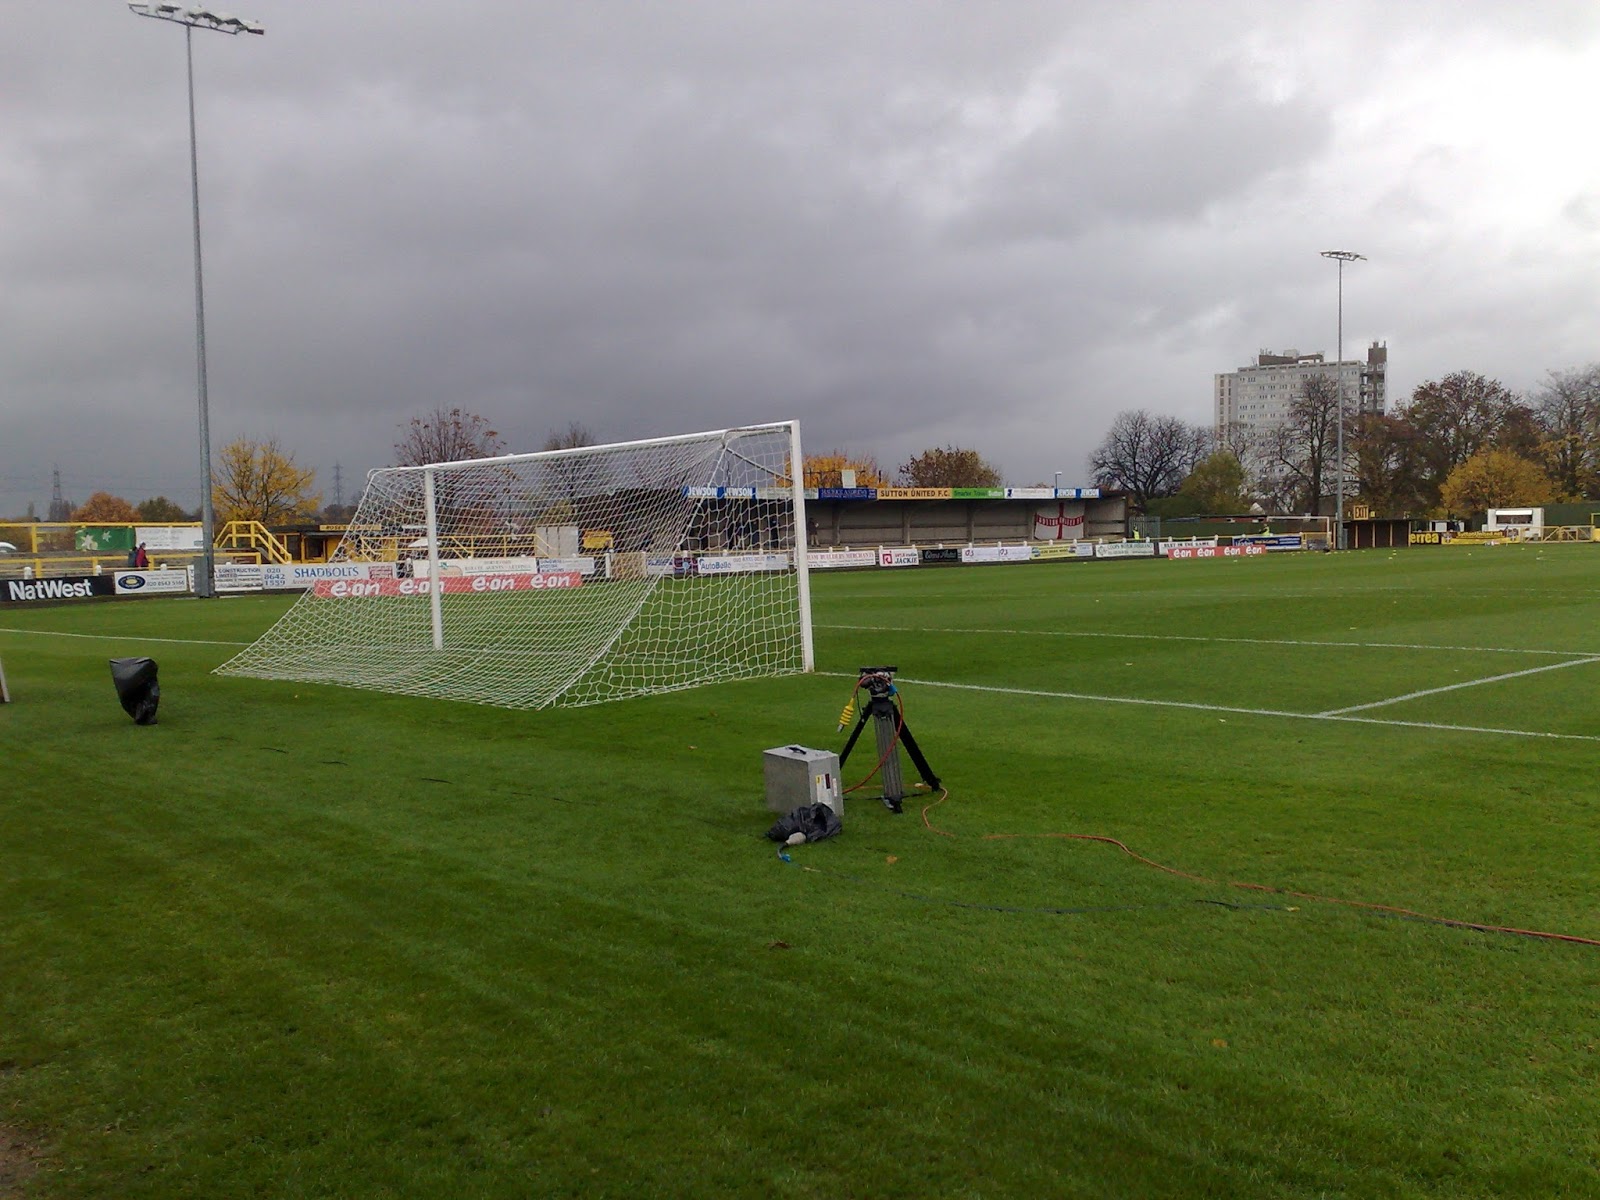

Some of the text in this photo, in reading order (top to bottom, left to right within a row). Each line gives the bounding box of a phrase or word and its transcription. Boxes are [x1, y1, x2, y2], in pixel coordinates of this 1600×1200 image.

[1355, 507, 1368, 518] EXIT
[294, 566, 359, 579] SHADBOLTS
[8, 578, 93, 601] NatWest
